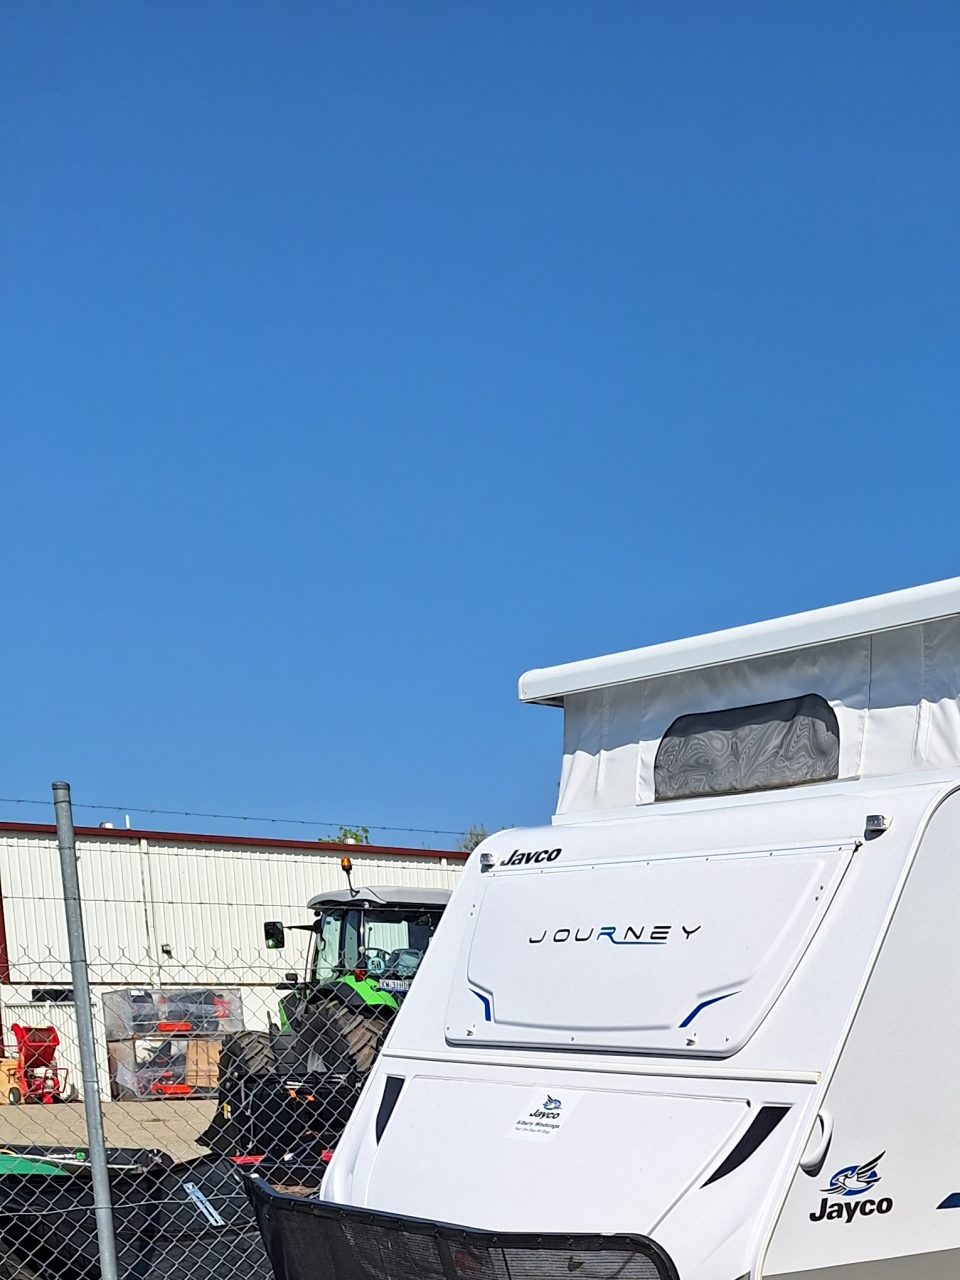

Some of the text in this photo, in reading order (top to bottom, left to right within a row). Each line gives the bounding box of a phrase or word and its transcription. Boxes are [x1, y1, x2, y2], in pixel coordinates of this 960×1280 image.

[528, 925, 702, 945] JOURNEY
[529, 1108, 561, 1120] Jayco
[809, 1197, 894, 1224] Jayco
